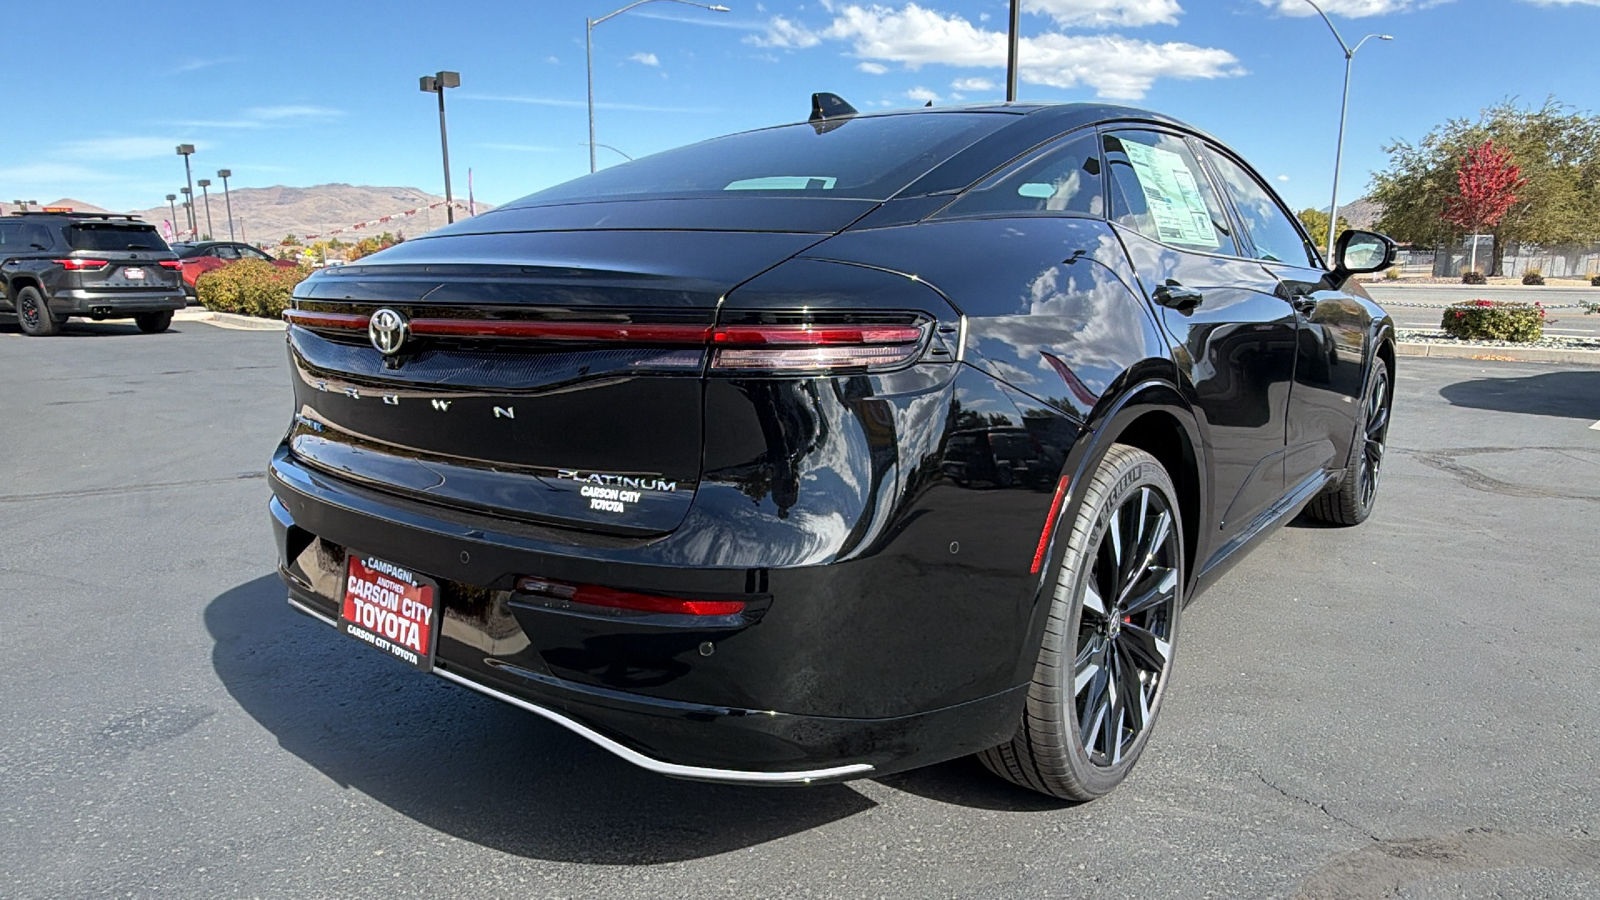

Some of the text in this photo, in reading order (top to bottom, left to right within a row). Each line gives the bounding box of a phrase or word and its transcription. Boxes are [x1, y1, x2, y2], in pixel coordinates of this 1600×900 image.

[557, 469, 677, 493] PLATINUM
[580, 485, 641, 503] CARSON CITY
[1099, 465, 1142, 524] MICHELIN
[590, 499, 624, 513] TOYOTA
[367, 556, 413, 584] CAMPAGNI
[376, 576, 405, 595] ANOTHER
[347, 575, 432, 626] CARSON CITY
[353, 597, 421, 651] TOYOTA
[346, 624, 418, 665] CARSON CITY TOYOTA
